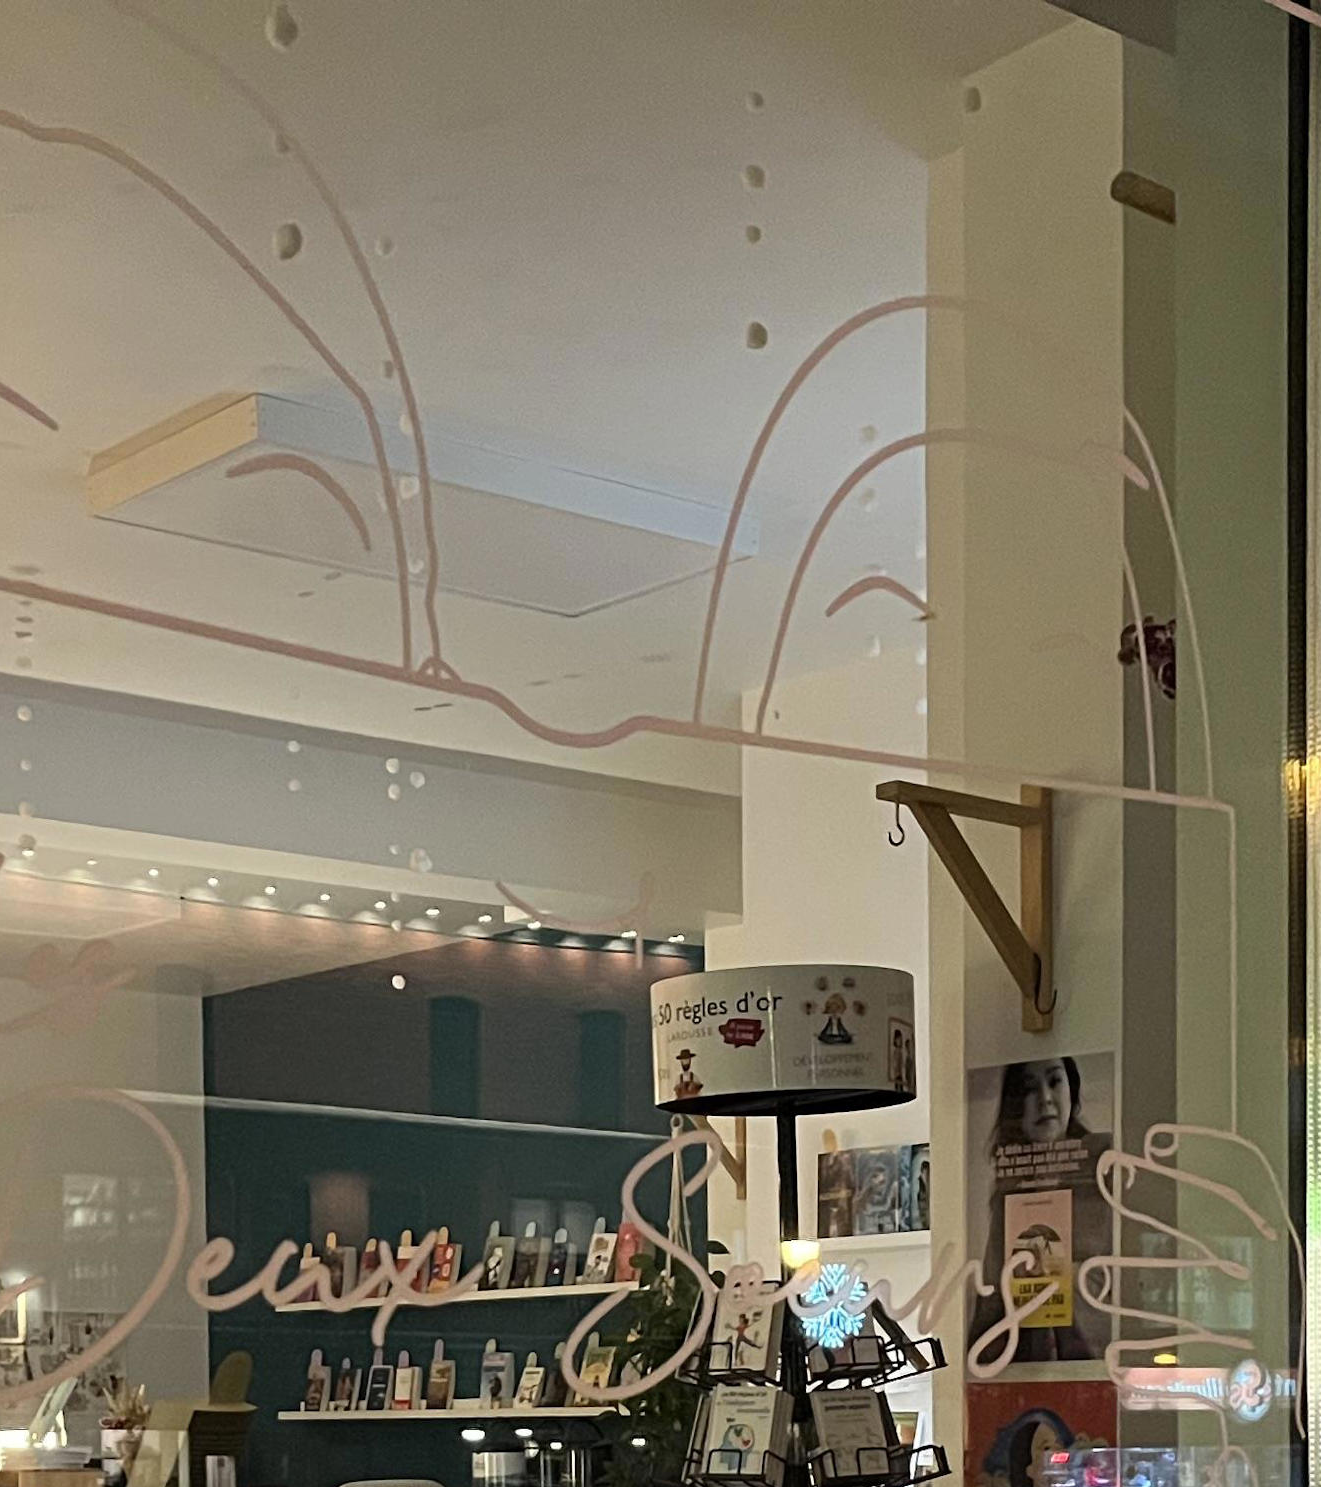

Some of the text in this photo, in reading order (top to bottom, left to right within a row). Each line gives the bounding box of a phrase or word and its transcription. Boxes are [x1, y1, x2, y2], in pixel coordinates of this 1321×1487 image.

[659, 991, 783, 1025] 50 règles d'or
